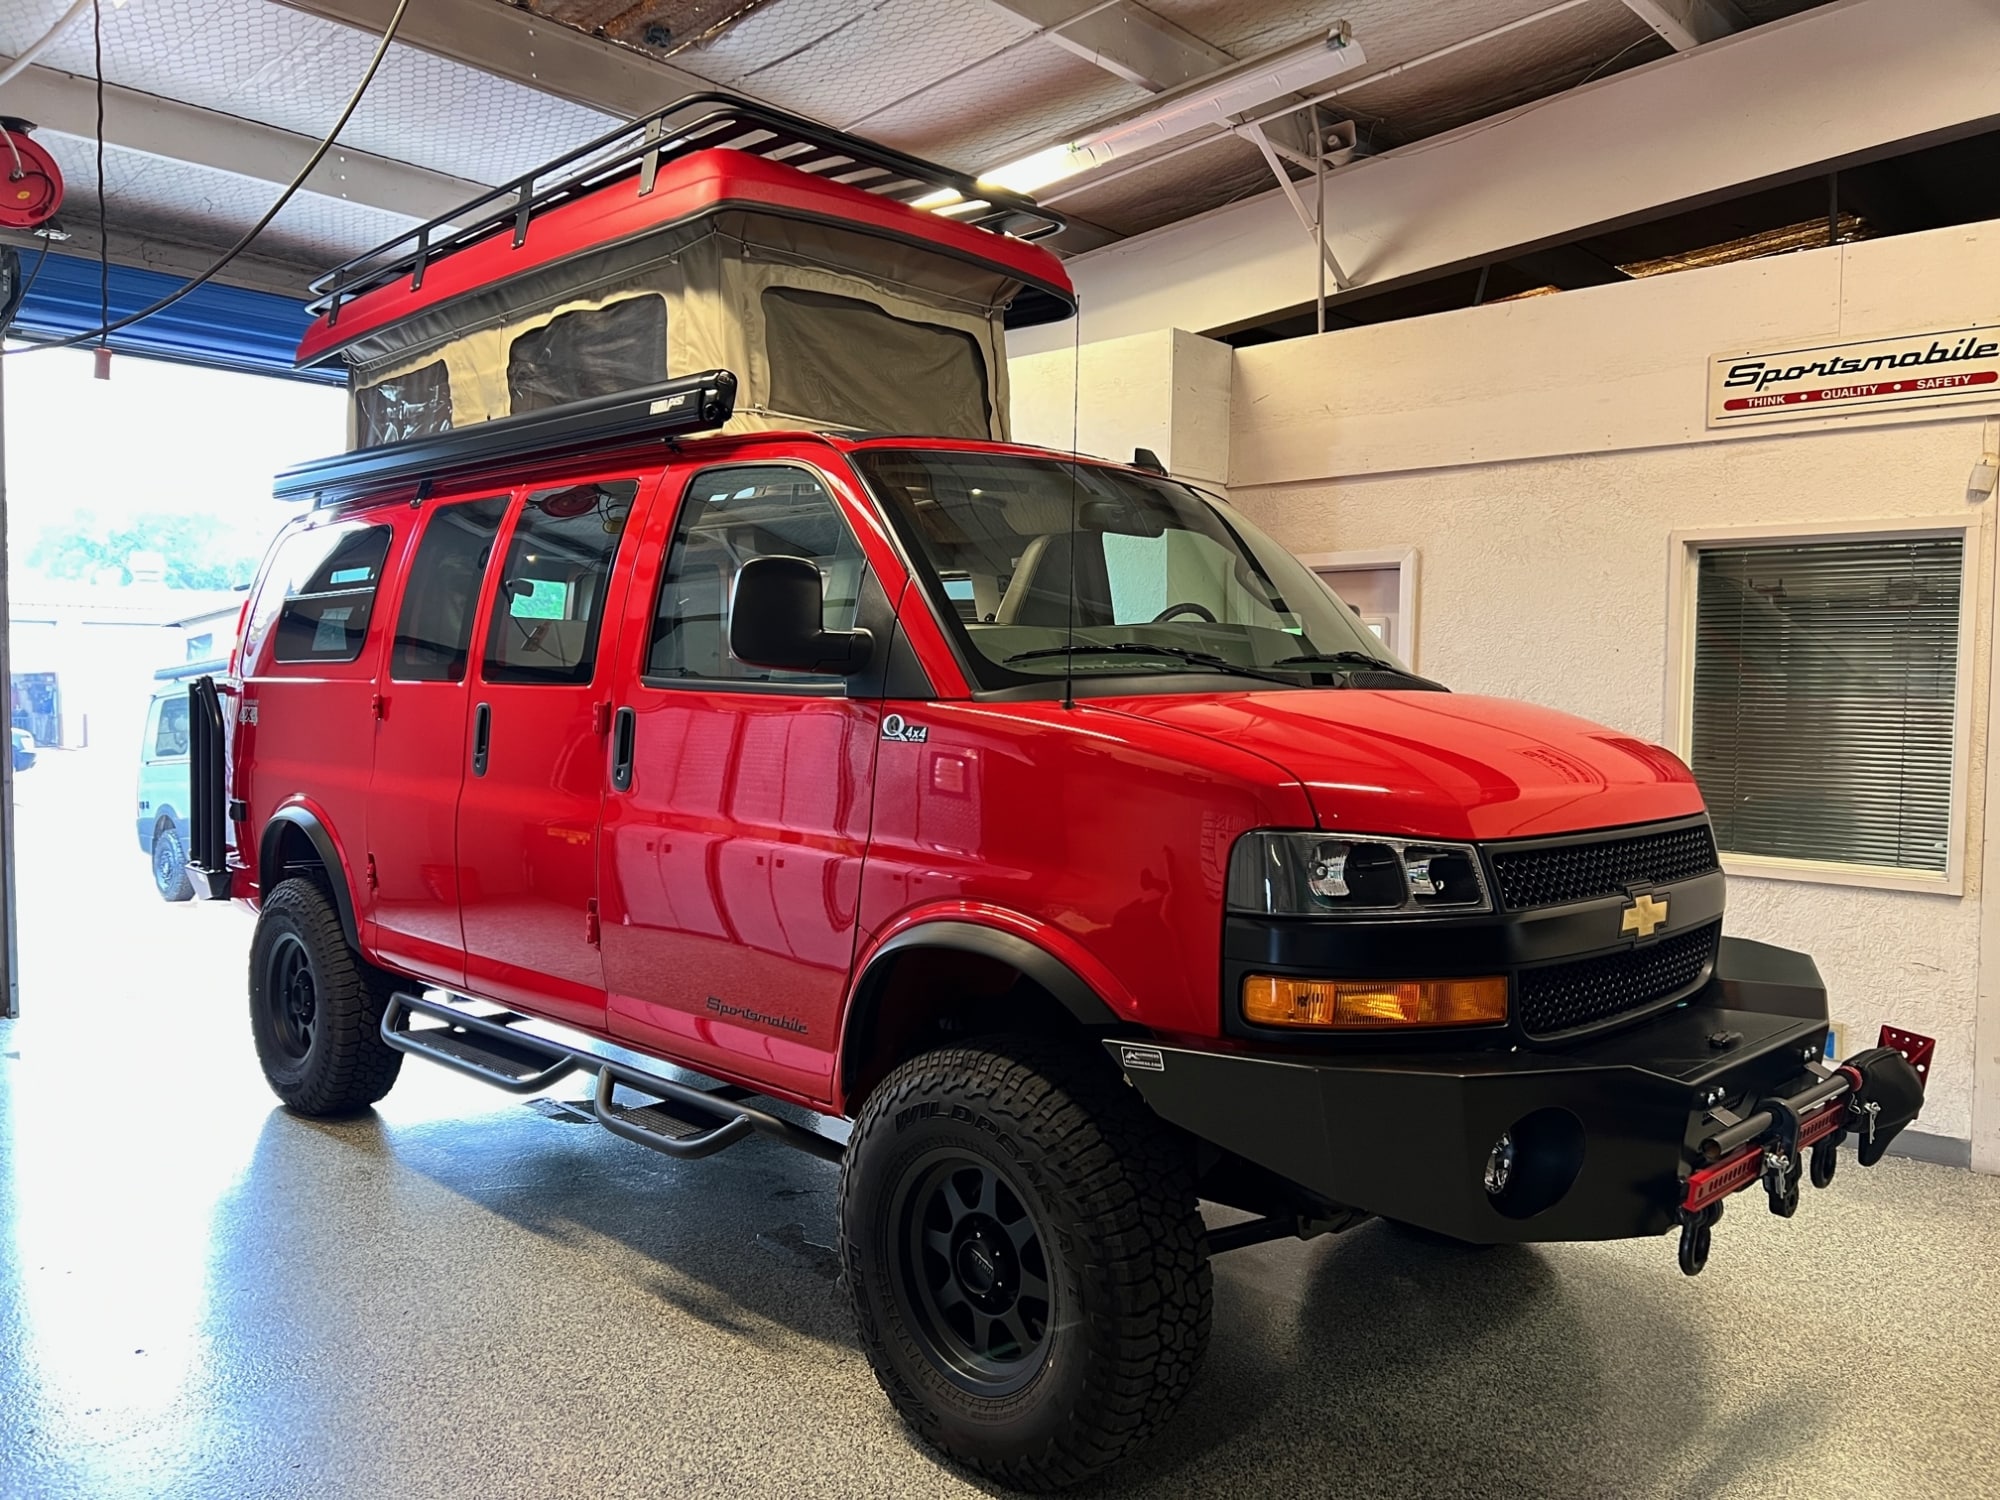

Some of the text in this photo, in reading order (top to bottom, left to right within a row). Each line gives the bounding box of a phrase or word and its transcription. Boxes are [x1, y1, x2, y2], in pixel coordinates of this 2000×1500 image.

[1724, 337, 2000, 392] Sportsmobile
[1747, 374, 1972, 408] THINK QUALITY SAFETY
[905, 726, 927, 739] 4x4
[706, 996, 808, 1035] Sportsmobile
[895, 1101, 1058, 1213] WILDPEAK
